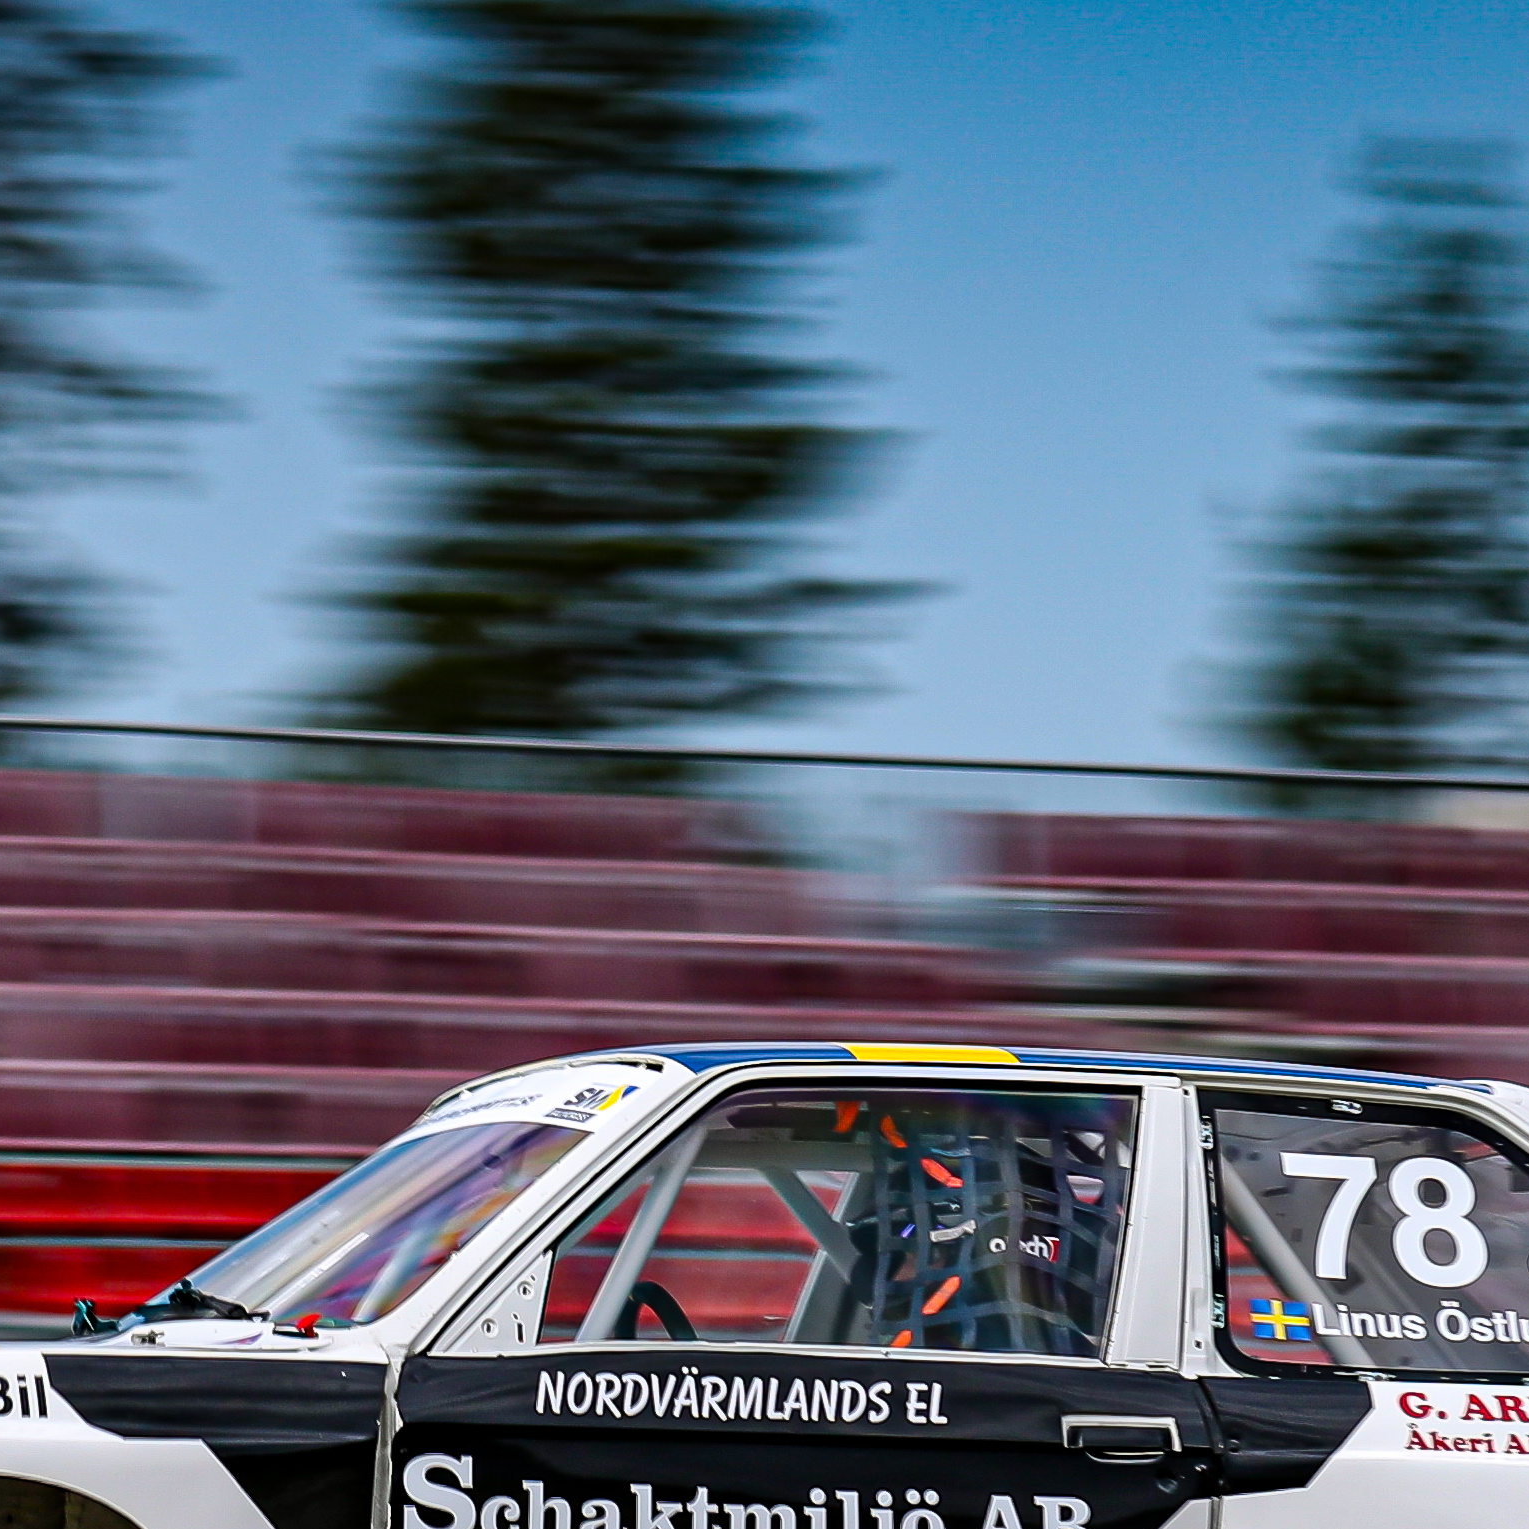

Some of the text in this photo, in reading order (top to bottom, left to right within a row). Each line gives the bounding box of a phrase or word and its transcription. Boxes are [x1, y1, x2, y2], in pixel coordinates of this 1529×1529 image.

[1280, 1152, 1489, 1288] 78
[1311, 1302, 1428, 1341] Linus
[533, 1366, 949, 1426] NORDVÄRMLANDS EL
[1397, 1391, 1449, 1421] G.
[1406, 1422, 1496, 1454] Åkeri
